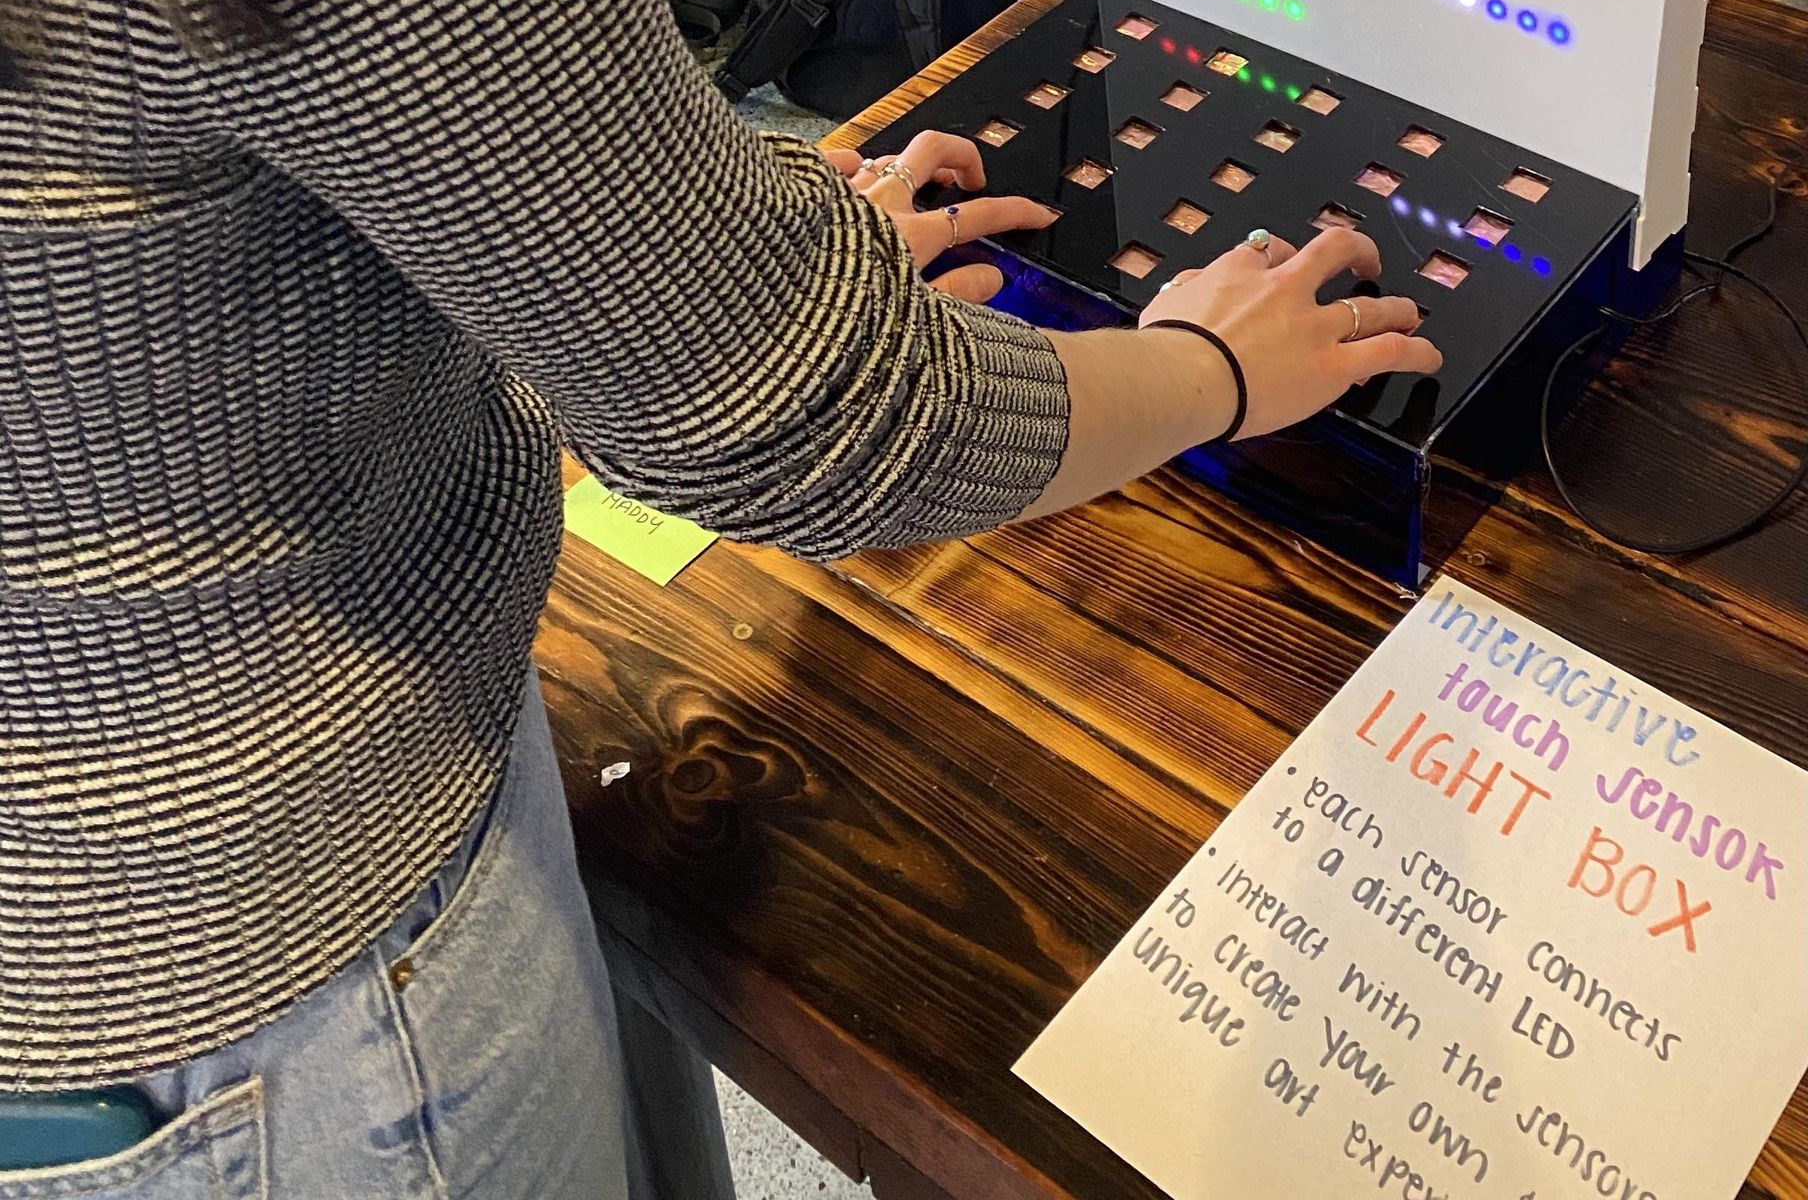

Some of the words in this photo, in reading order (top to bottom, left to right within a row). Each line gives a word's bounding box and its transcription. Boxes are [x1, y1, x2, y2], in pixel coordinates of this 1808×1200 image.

[1428, 591, 1700, 767] Interactive
[1437, 661, 1570, 772] touch
[1272, 806, 1305, 843] to
[1317, 847, 1345, 877] a
[1351, 876, 1503, 1003] different
[1511, 996, 1576, 1060] LED
[1303, 776, 1384, 849] each
[1401, 850, 1508, 935] sensor
[1527, 941, 1682, 1062] connects
[1356, 688, 1552, 835] LIGHT
[1567, 825, 1713, 953] BOX
[1132, 926, 1246, 1048] unique
[1264, 1057, 1320, 1118] art
[1165, 887, 1196, 929] to
[1214, 933, 1301, 1022] create
[1319, 1015, 1396, 1096] your
[1408, 1101, 1490, 1184] own
[1216, 859, 1329, 961] interact
[1338, 962, 1421, 1041] with
[1443, 1042, 1502, 1104] the
[1516, 1104, 1658, 1200] sensor
